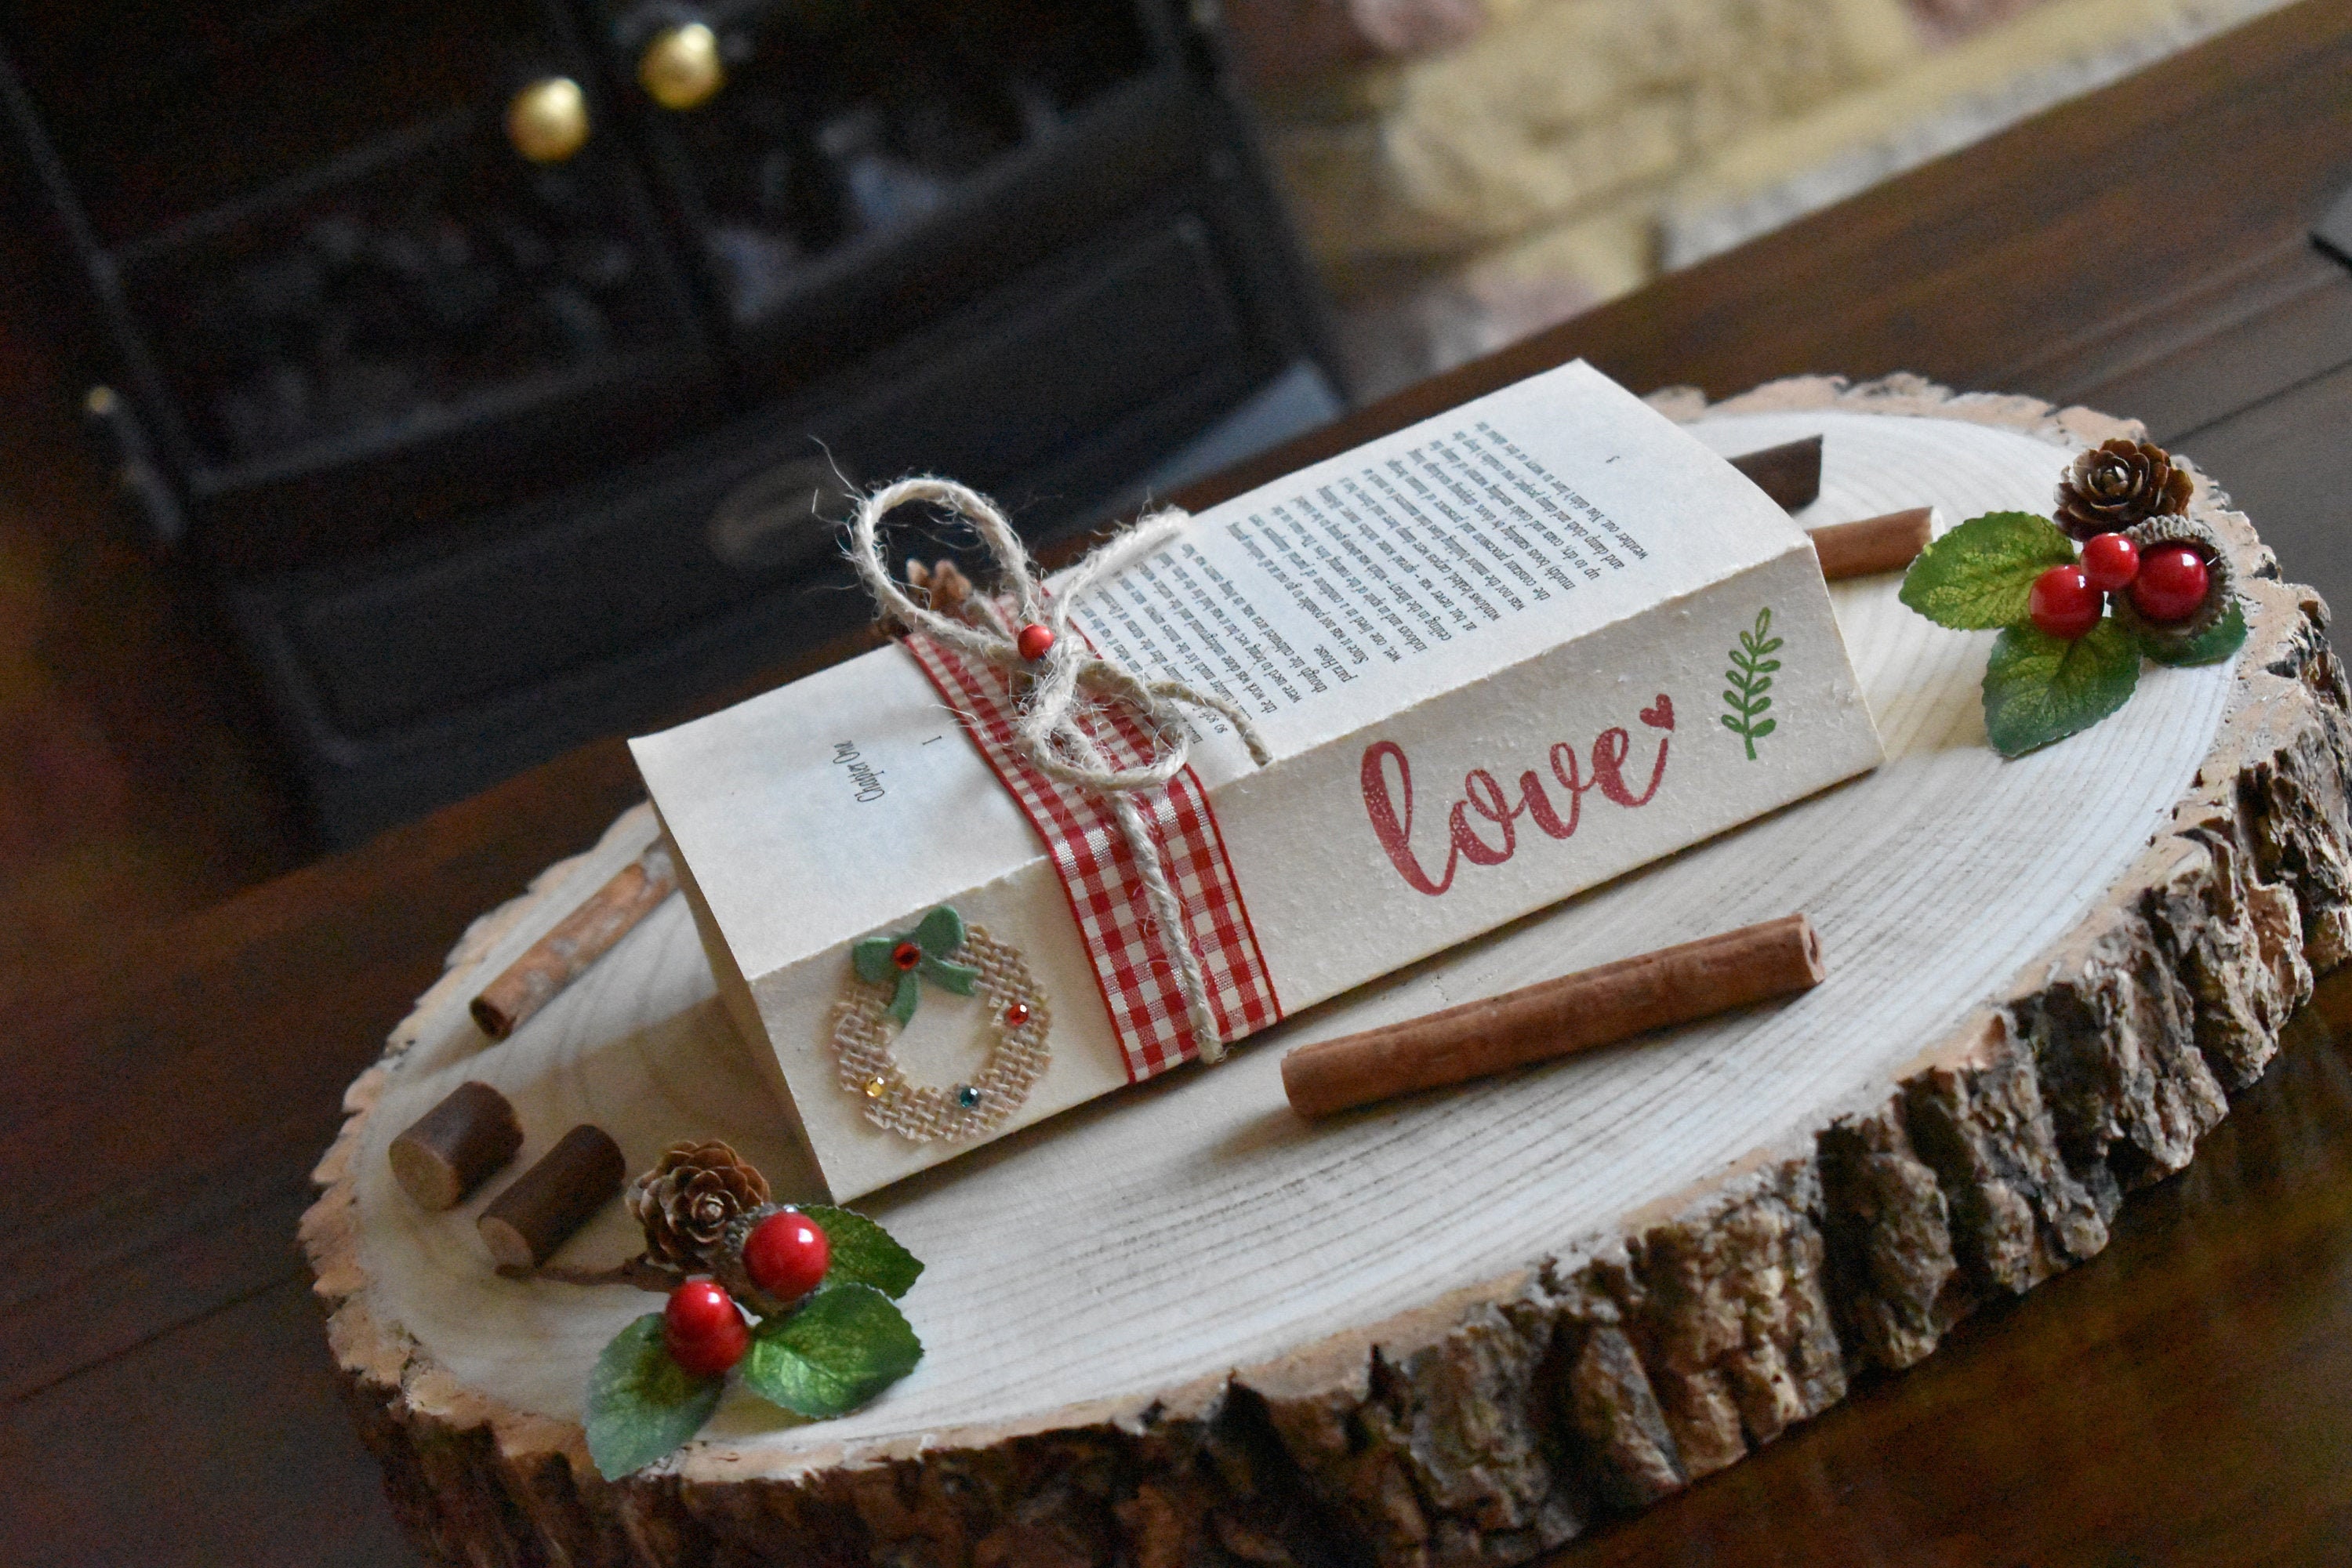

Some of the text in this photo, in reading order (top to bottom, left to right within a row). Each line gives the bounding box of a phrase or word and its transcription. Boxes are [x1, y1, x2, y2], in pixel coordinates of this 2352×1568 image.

[1548, 511, 1569, 523] and
[1584, 508, 1603, 524] You
[1523, 521, 1544, 533] and
[1561, 521, 1587, 538] cloth
[1541, 532, 1563, 547] coats
[1582, 534, 1609, 557] damp
[1615, 532, 1650, 559] weather
[1526, 549, 1549, 569] boots
[1573, 559, 1587, 569] to
[1600, 554, 1625, 569] and
[1501, 561, 1536, 587] constant
[1544, 564, 1576, 590] muddy
[1584, 565, 1601, 579] up
[1417, 579, 1433, 590] was
[1483, 575, 1499, 587] the
[1429, 590, 1453, 608] never
[1493, 585, 1512, 598] not
[1533, 586, 1552, 601] the
[1363, 593, 1385, 608] spite
[1405, 601, 1421, 613] the
[1468, 593, 1502, 621] windows
[1508, 597, 1526, 611] was
[1345, 608, 1357, 619] in
[1377, 606, 1388, 615] in
[1417, 611, 1429, 621] in
[1447, 608, 1467, 623] but
[1317, 617, 1334, 629] not
[1348, 616, 1373, 634] lived
[1380, 613, 1402, 627] and
[1461, 622, 1477, 631] at
[1330, 627, 1345, 640] was
[1425, 615, 1453, 641] ceiling
[1259, 629, 1294, 657] cultivated
[1338, 638, 1352, 648] it
[1369, 632, 1386, 646] one
[1397, 626, 1428, 653] indoors
[1245, 642, 1265, 665] being
[1346, 644, 1368, 665] Since
[1382, 644, 1403, 662] wet,
[1221, 655, 1240, 673] done
[1261, 661, 1272, 671] to
[1287, 655, 1304, 669] the
[1314, 644, 1358, 682] para House.
[1263, 669, 1287, 686] used
[1295, 667, 1327, 693] though
[1242, 682, 1265, 699] work
[1282, 684, 1303, 702] were
[1260, 699, 1278, 713] the
[1214, 723, 1228, 734] so
[833, 740, 885, 802] Chapter One
[1360, 727, 1668, 897] love
